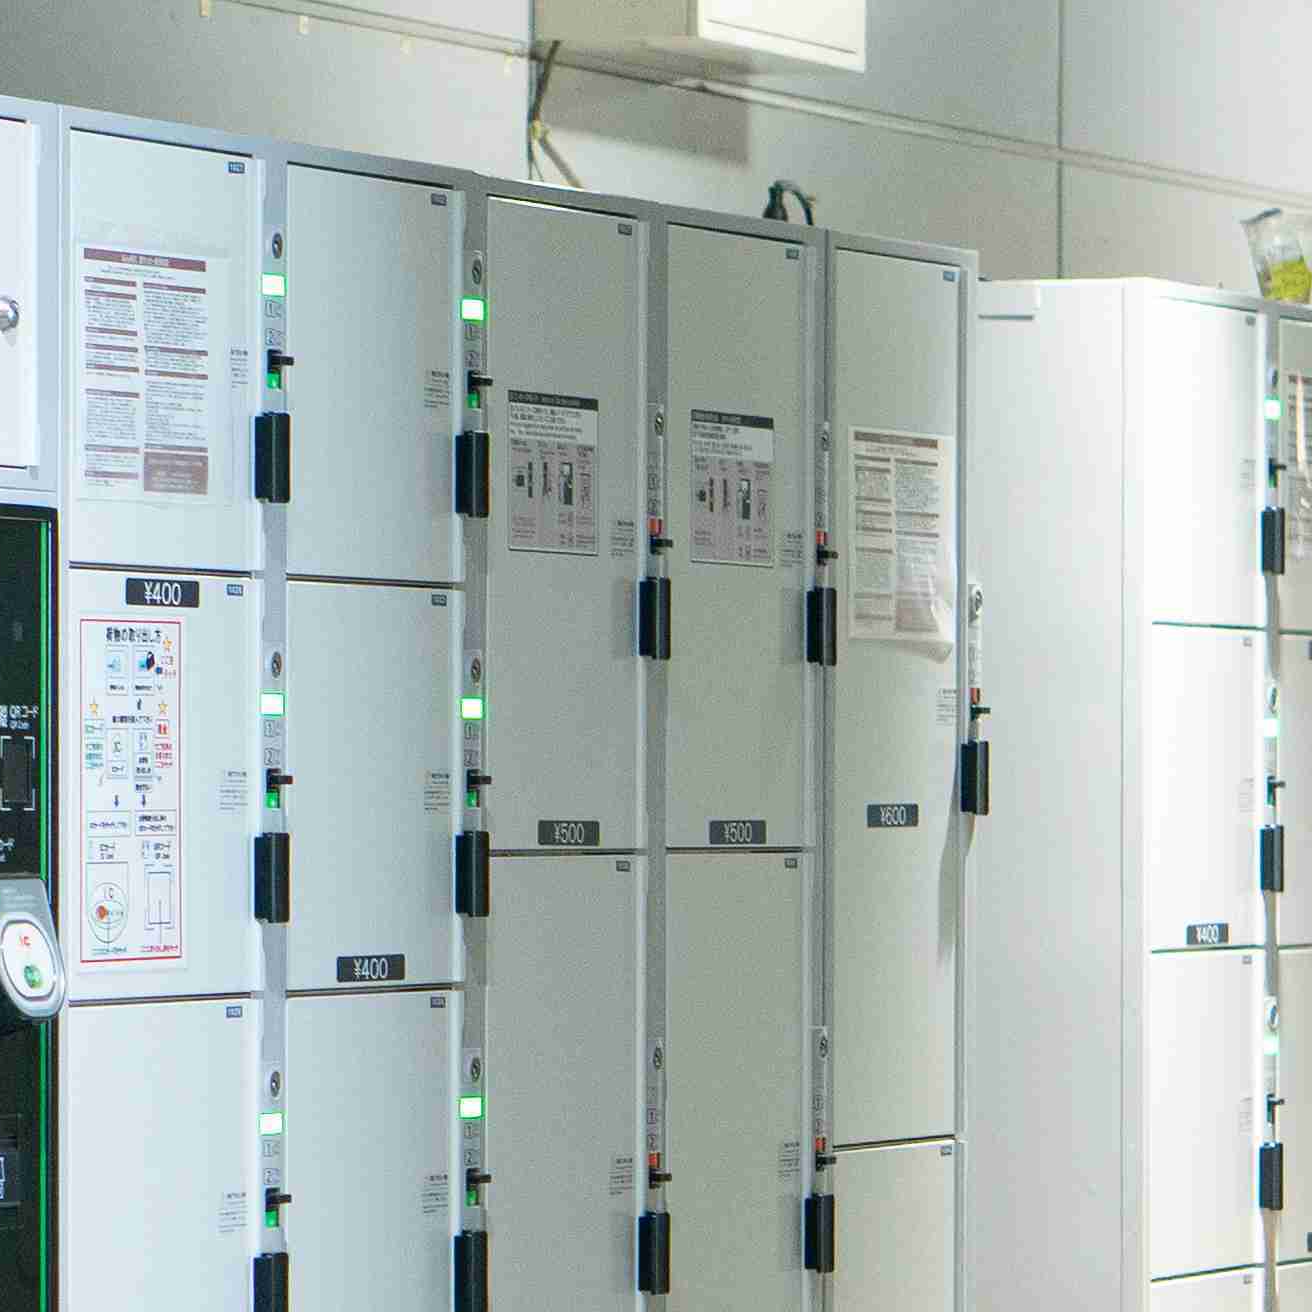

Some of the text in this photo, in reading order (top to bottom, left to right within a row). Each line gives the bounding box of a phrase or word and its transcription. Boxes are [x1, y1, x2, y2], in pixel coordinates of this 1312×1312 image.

[145, 582, 182, 605] ¥400
[554, 824, 584, 843] ¥500
[724, 824, 752, 842] ¥500
[354, 955, 388, 979] ¥400
